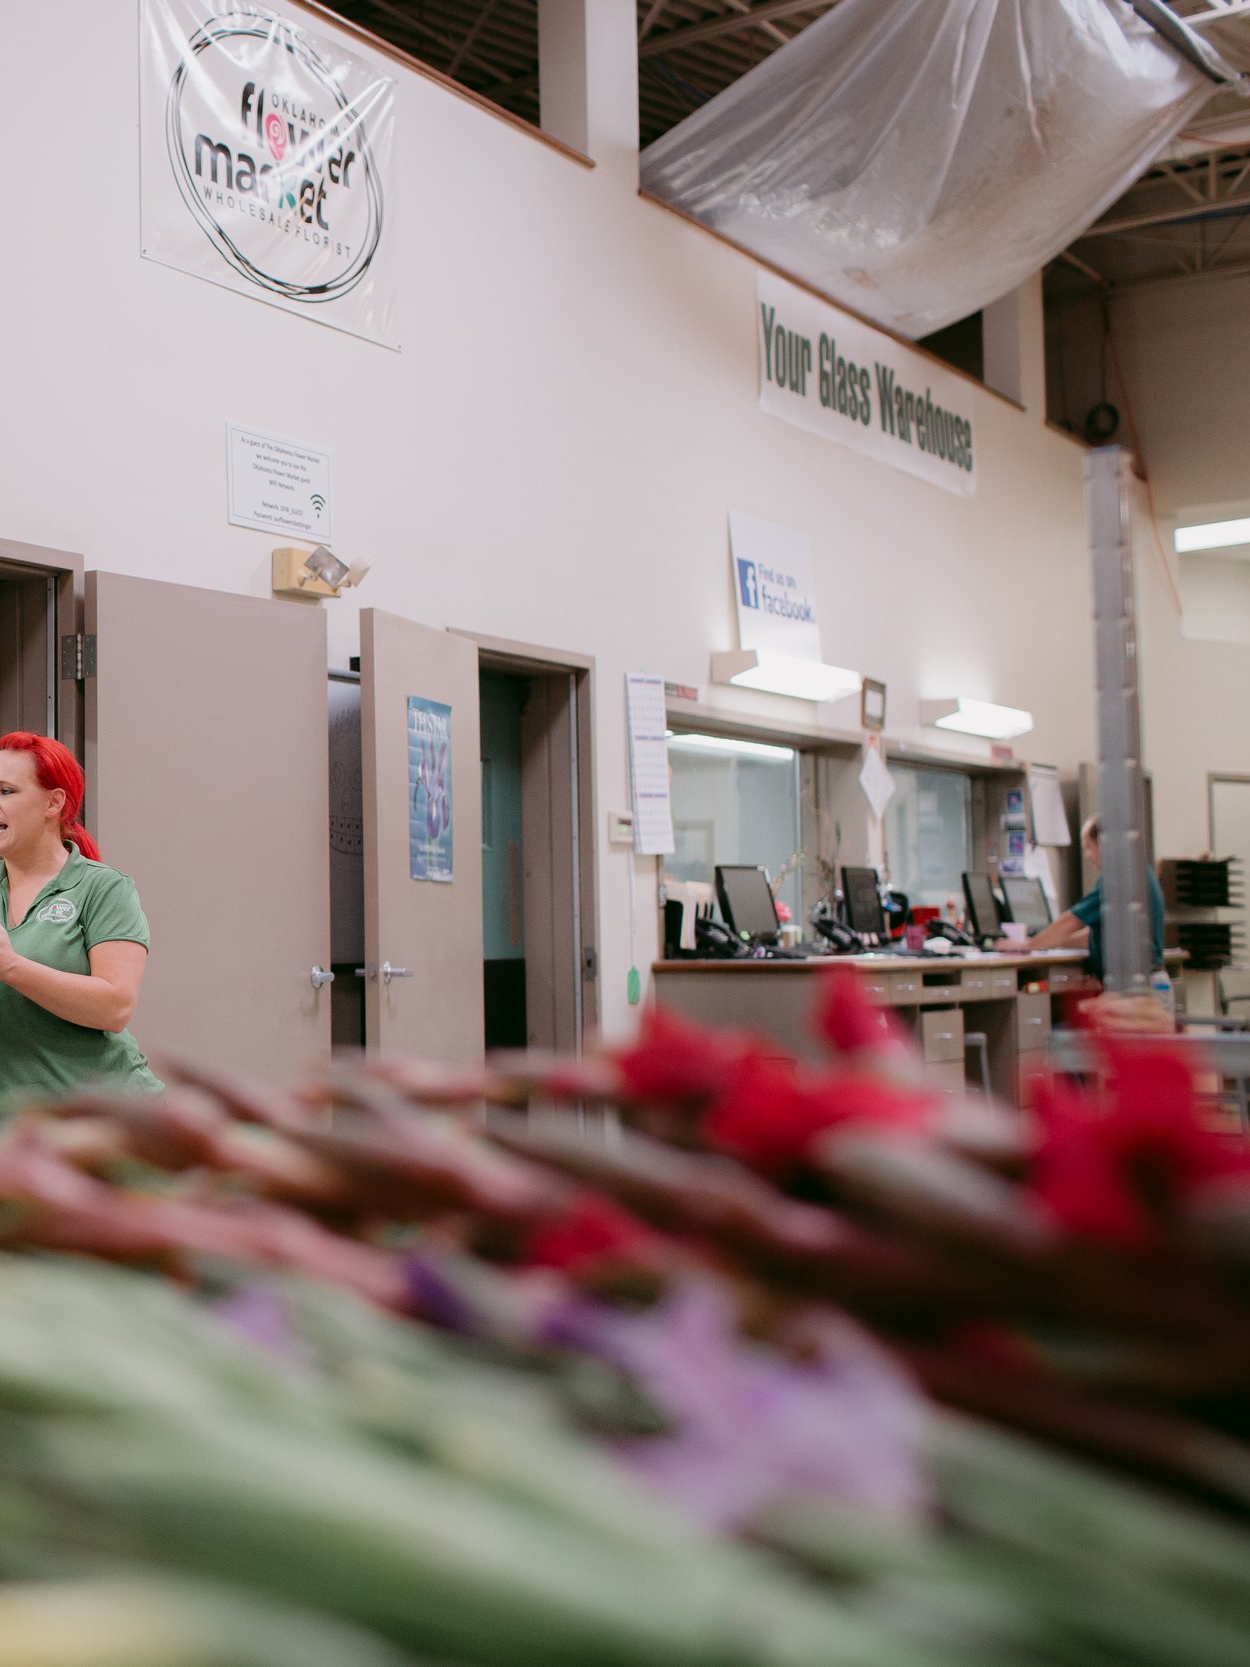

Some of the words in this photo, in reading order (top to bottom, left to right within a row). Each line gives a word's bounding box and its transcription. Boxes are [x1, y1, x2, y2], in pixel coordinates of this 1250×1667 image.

[271, 94, 350, 142] OKLAHOM
[761, 301, 812, 397] Your
[818, 331, 871, 427] Glass
[875, 361, 974, 473] Warehouse
